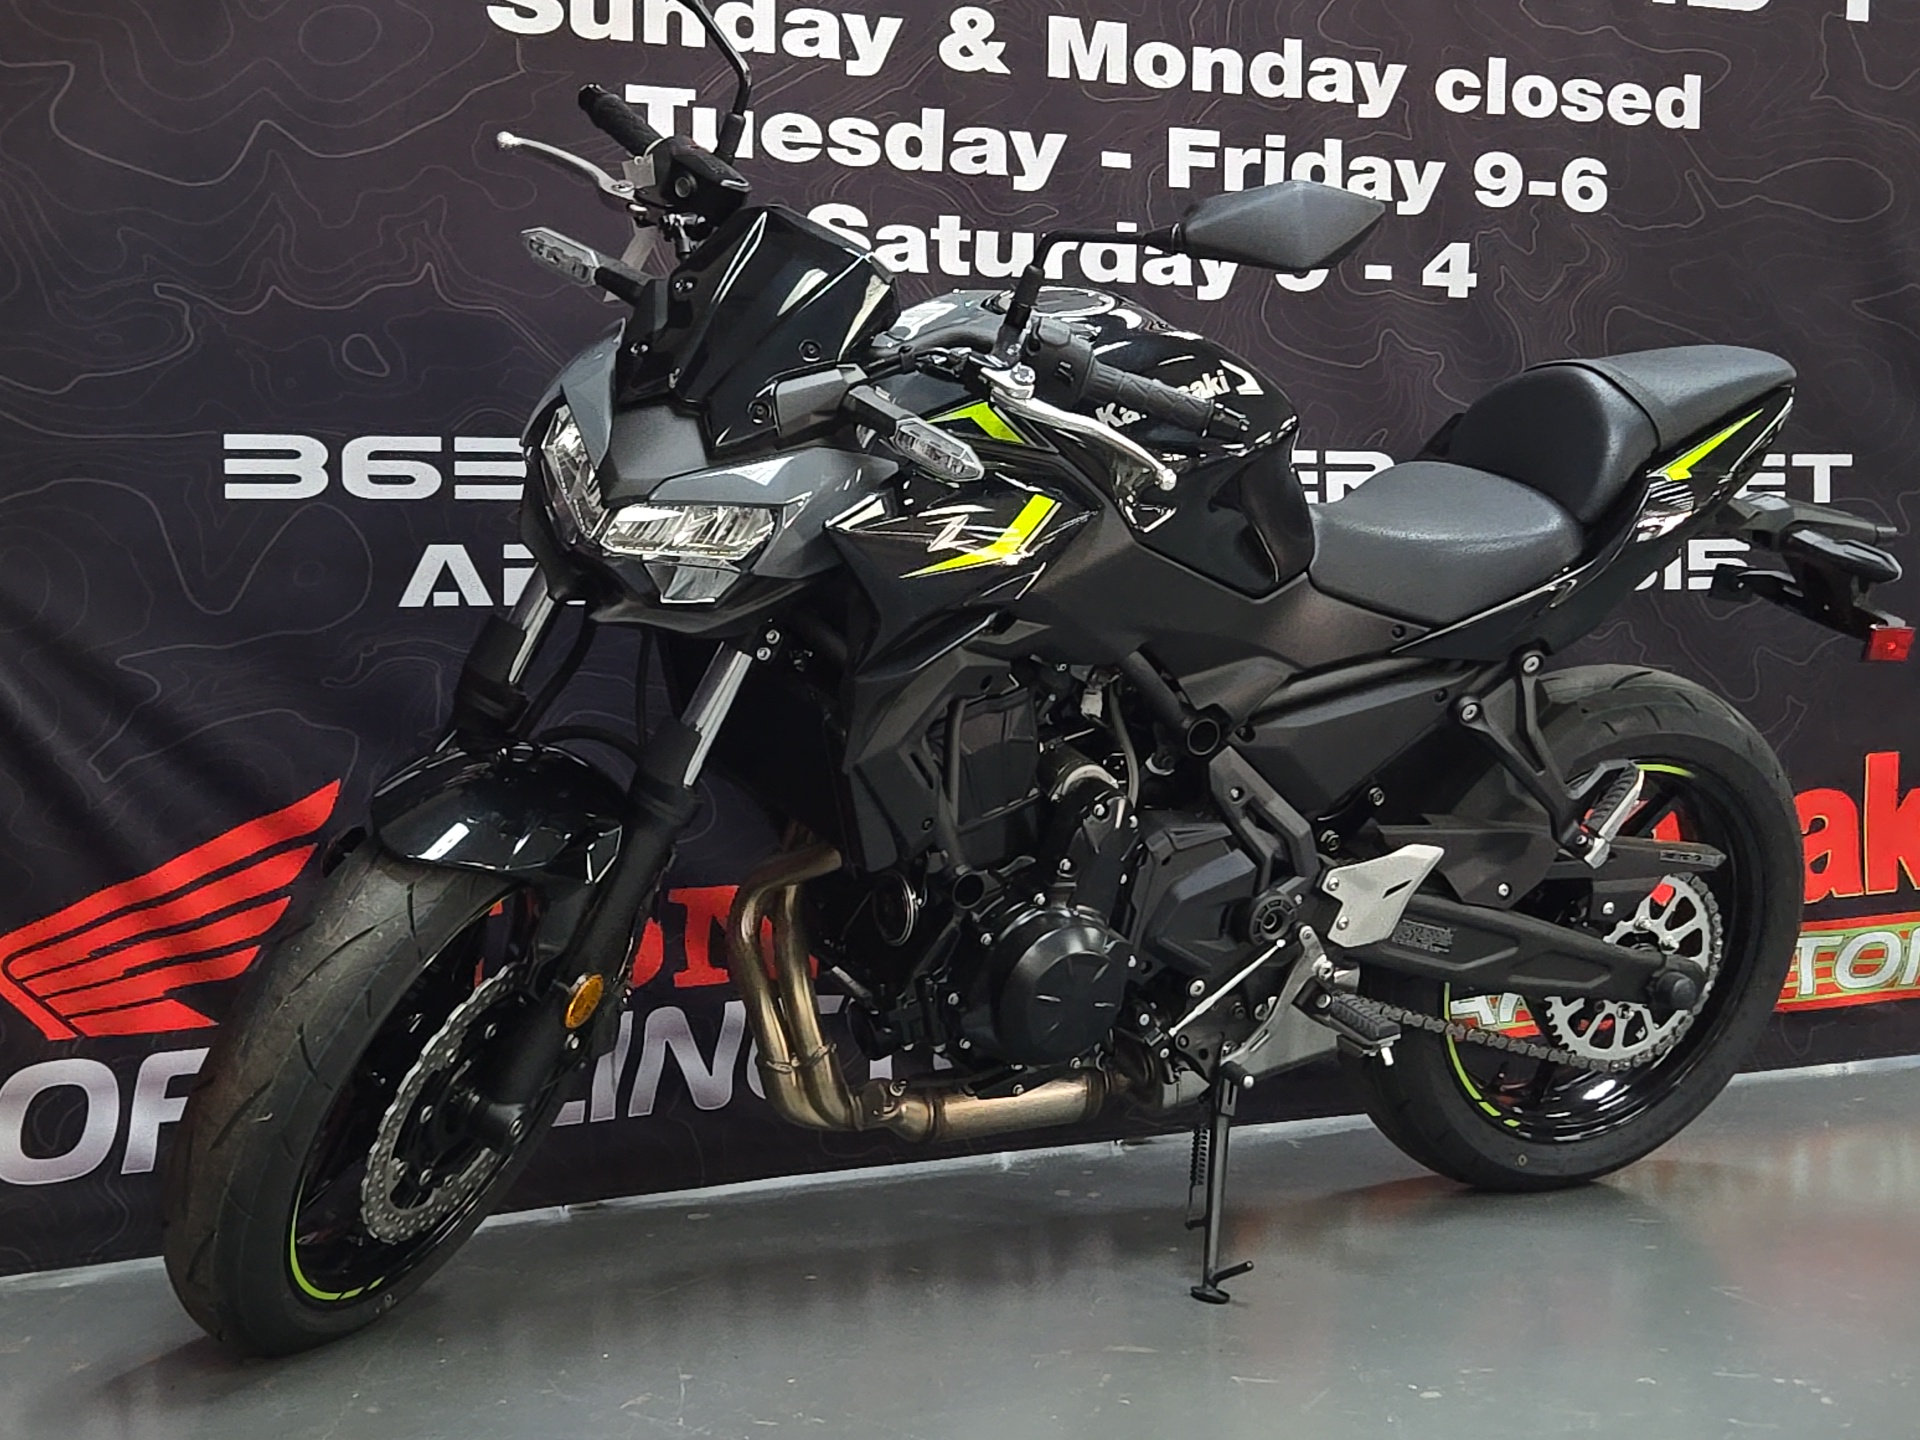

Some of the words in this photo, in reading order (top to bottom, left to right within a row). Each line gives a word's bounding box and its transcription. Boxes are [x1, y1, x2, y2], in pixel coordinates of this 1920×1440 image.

[938, 6, 1011, 75] &
[1047, 15, 1408, 119] Monday
[1434, 56, 1702, 130] closed
[625, 83, 1068, 192] Tuesday
[1168, 126, 1447, 216] Friday
[1473, 151, 1608, 213] 9-6
[806, 202, 1239, 301] Saturday
[1421, 242, 1478, 299] 4
[0, 1047, 210, 1186] OF
